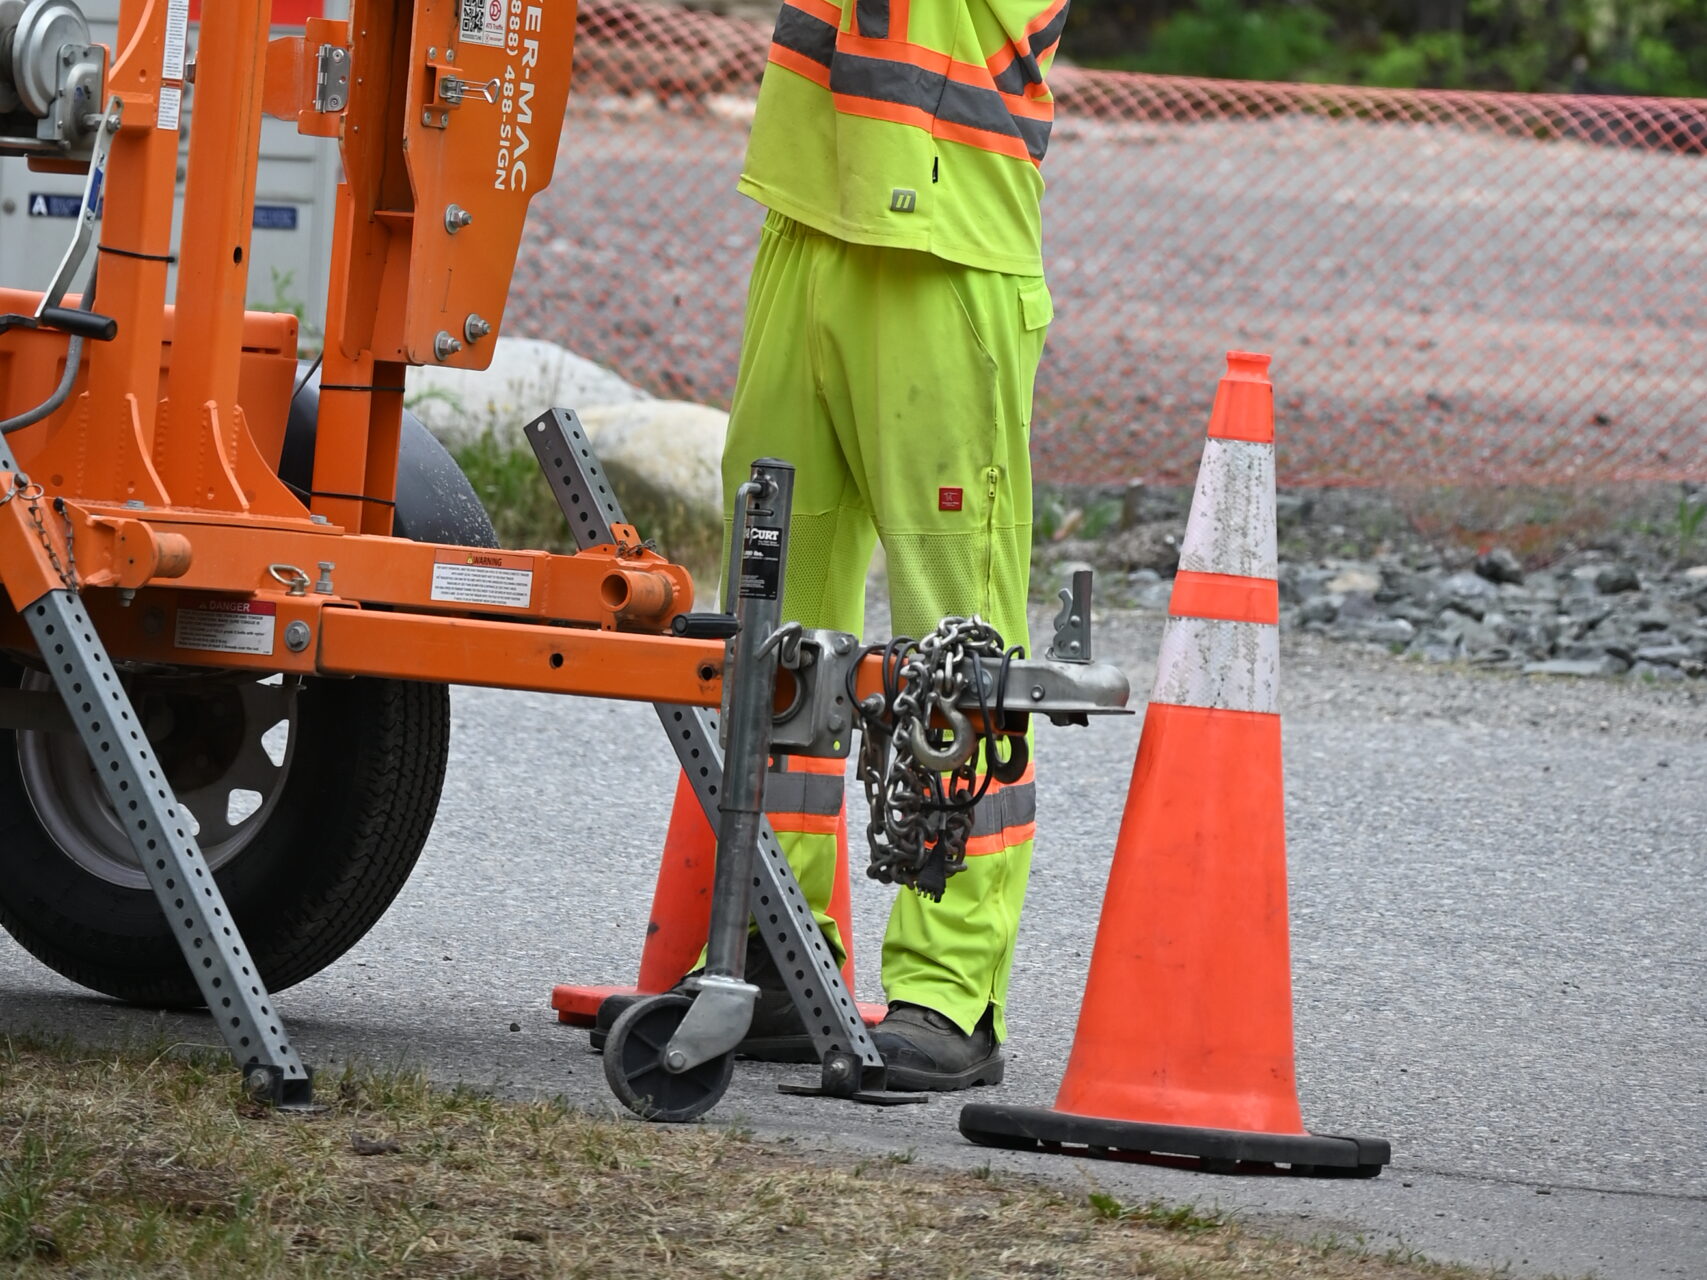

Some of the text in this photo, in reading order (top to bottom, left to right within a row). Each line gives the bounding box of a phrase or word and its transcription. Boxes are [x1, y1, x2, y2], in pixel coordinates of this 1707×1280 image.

[494, 64, 515, 191] 488-SIGN
[32, 195, 48, 216] A
[751, 528, 779, 540] CURT
[474, 556, 502, 567] WARNING
[209, 600, 250, 612] DANGER
